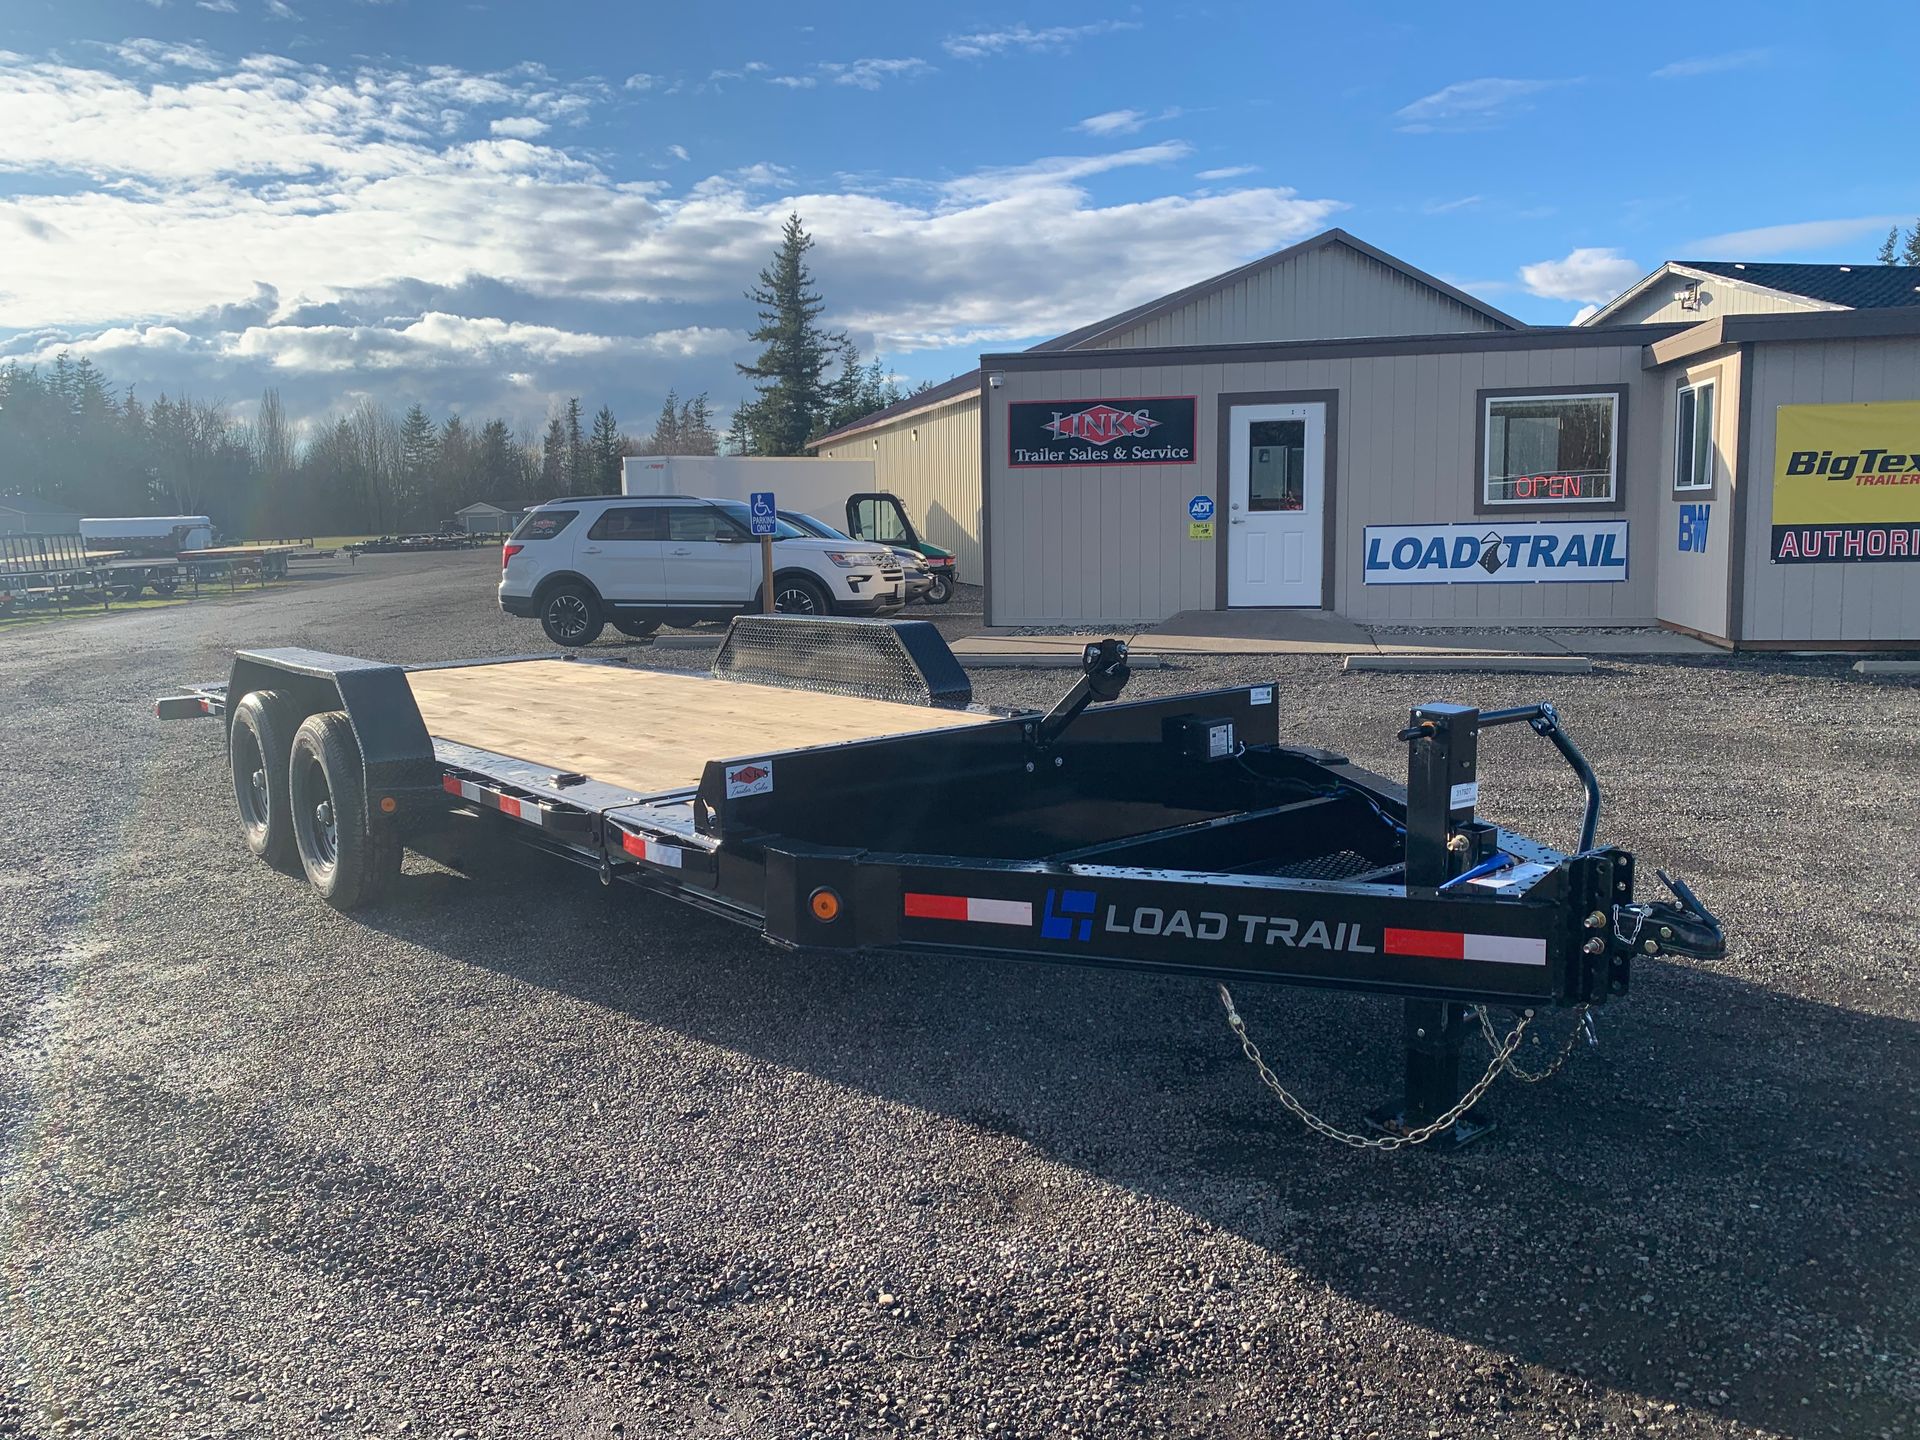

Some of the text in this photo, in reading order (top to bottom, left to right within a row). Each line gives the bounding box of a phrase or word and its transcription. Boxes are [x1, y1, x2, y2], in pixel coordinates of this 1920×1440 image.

[1051, 408, 1150, 441] LINKS
[1015, 445, 1189, 462] Trailer Sales & Service
[1516, 475, 1581, 497] OPEN
[1191, 501, 1212, 513] ADT
[752, 516, 775, 525] PARKING
[756, 524, 771, 533] ONLY
[1366, 533, 1626, 570] LOAD TRAIL
[1105, 904, 1376, 954] LOAD TRAIL
